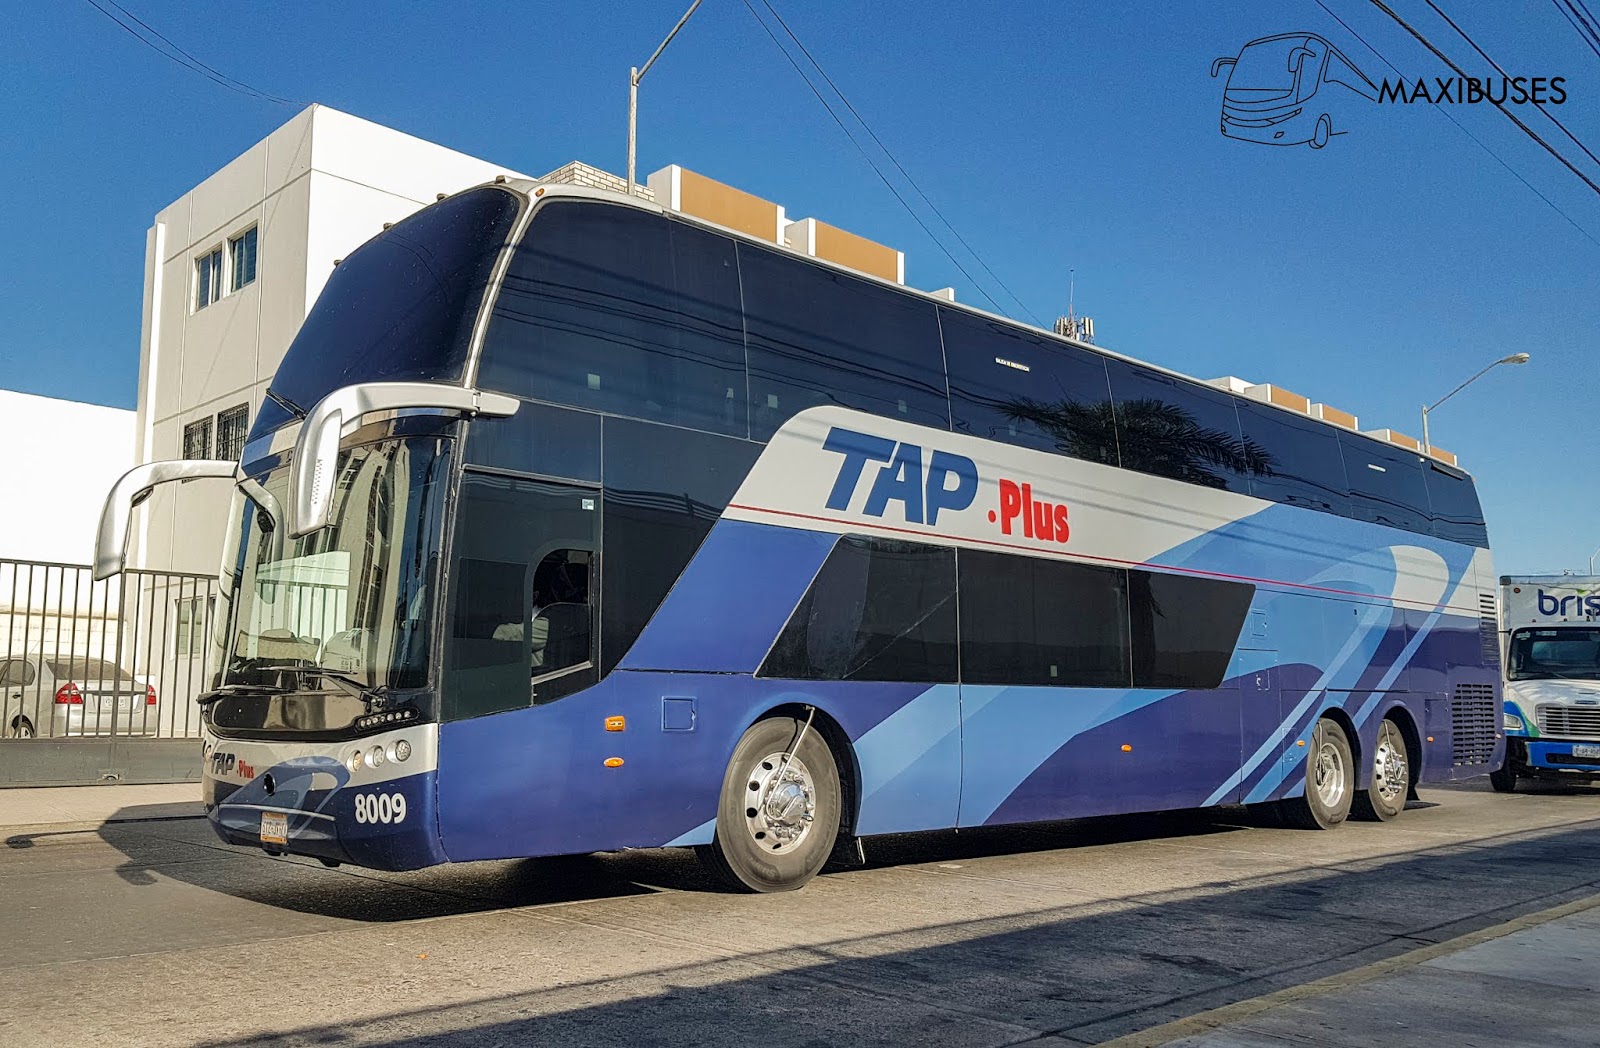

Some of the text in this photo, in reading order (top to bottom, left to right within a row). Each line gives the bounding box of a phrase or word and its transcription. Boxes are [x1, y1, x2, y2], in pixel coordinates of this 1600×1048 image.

[822, 426, 979, 526] TAP
[211, 752, 235, 775] TAP
[355, 793, 407, 824] 8009
